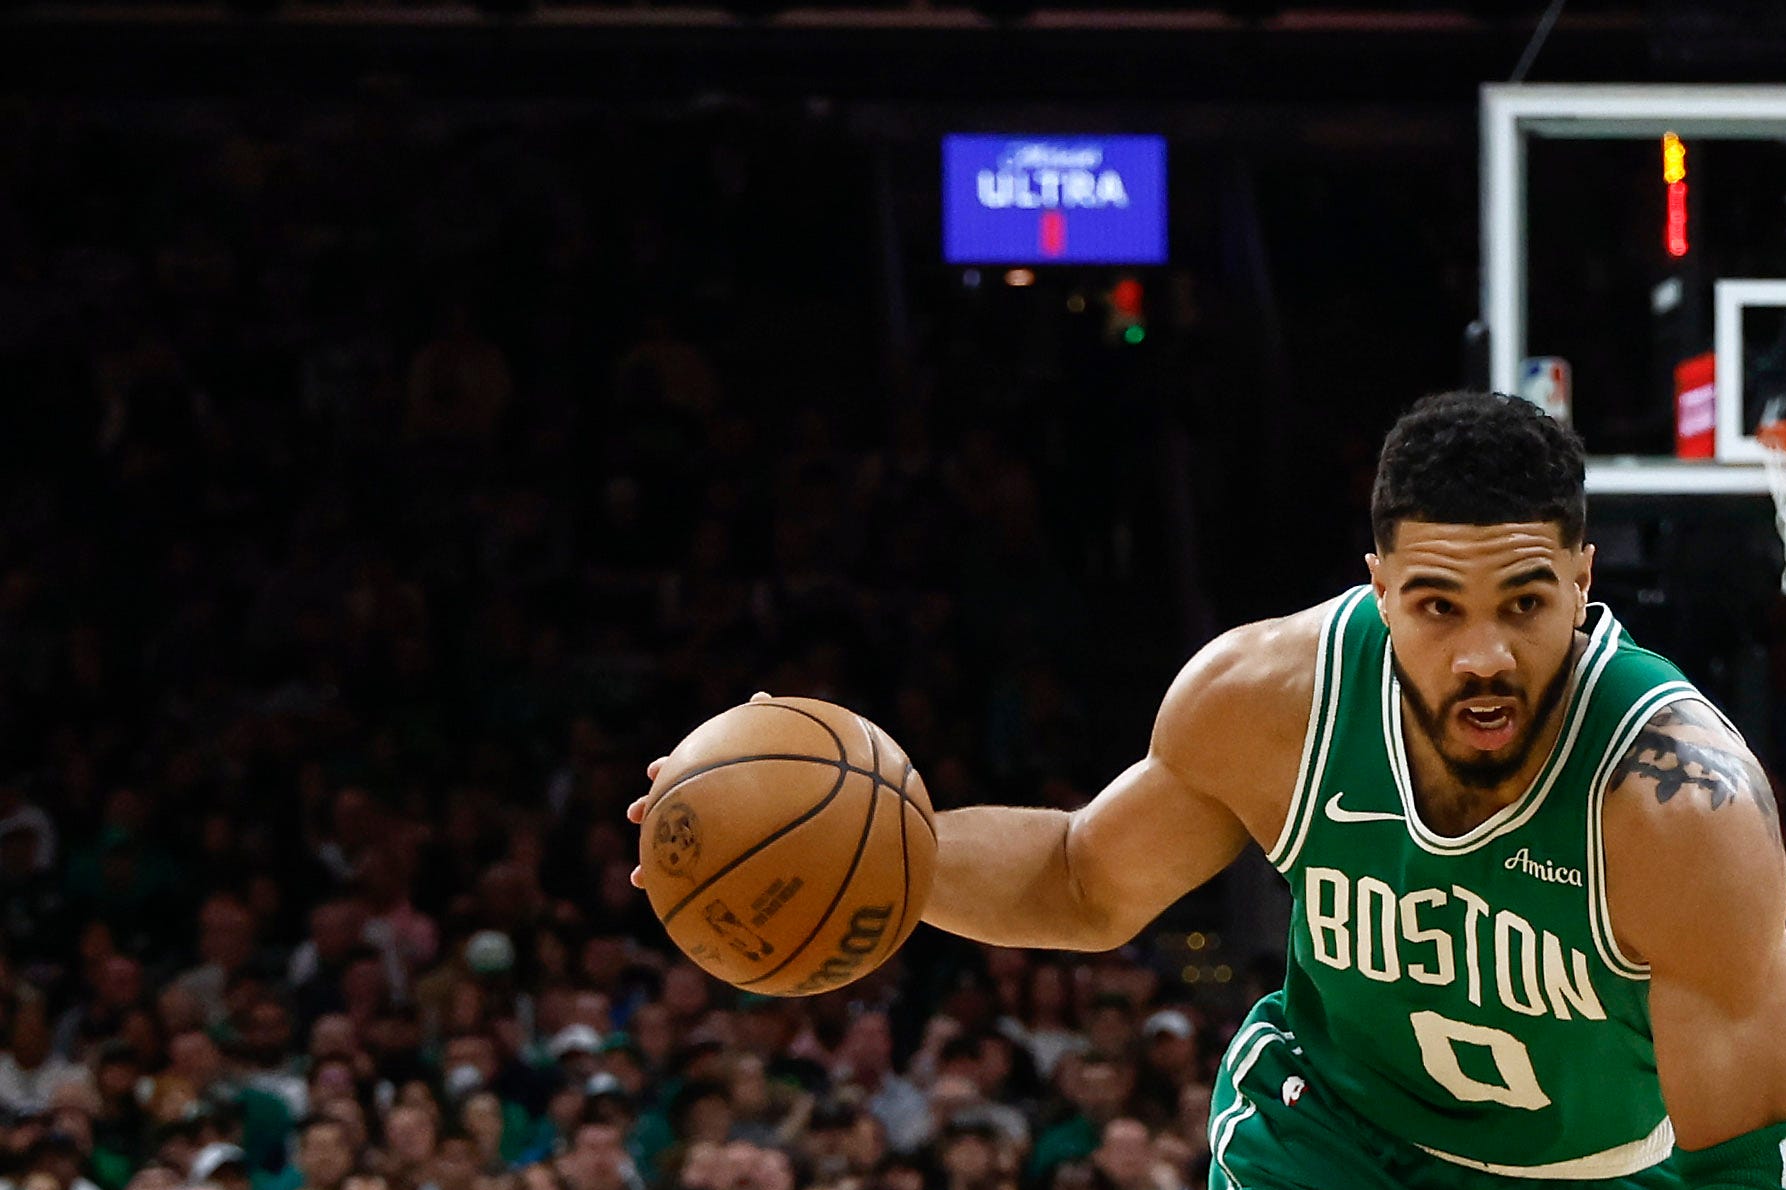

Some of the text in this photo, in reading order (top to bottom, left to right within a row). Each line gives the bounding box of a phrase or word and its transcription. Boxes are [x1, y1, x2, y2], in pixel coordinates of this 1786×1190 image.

[977, 167, 1130, 209] ULTRA
[1504, 848, 1583, 888] Amica
[1305, 866, 1607, 1021] BOSTON
[1409, 1010, 1552, 1111] 0
